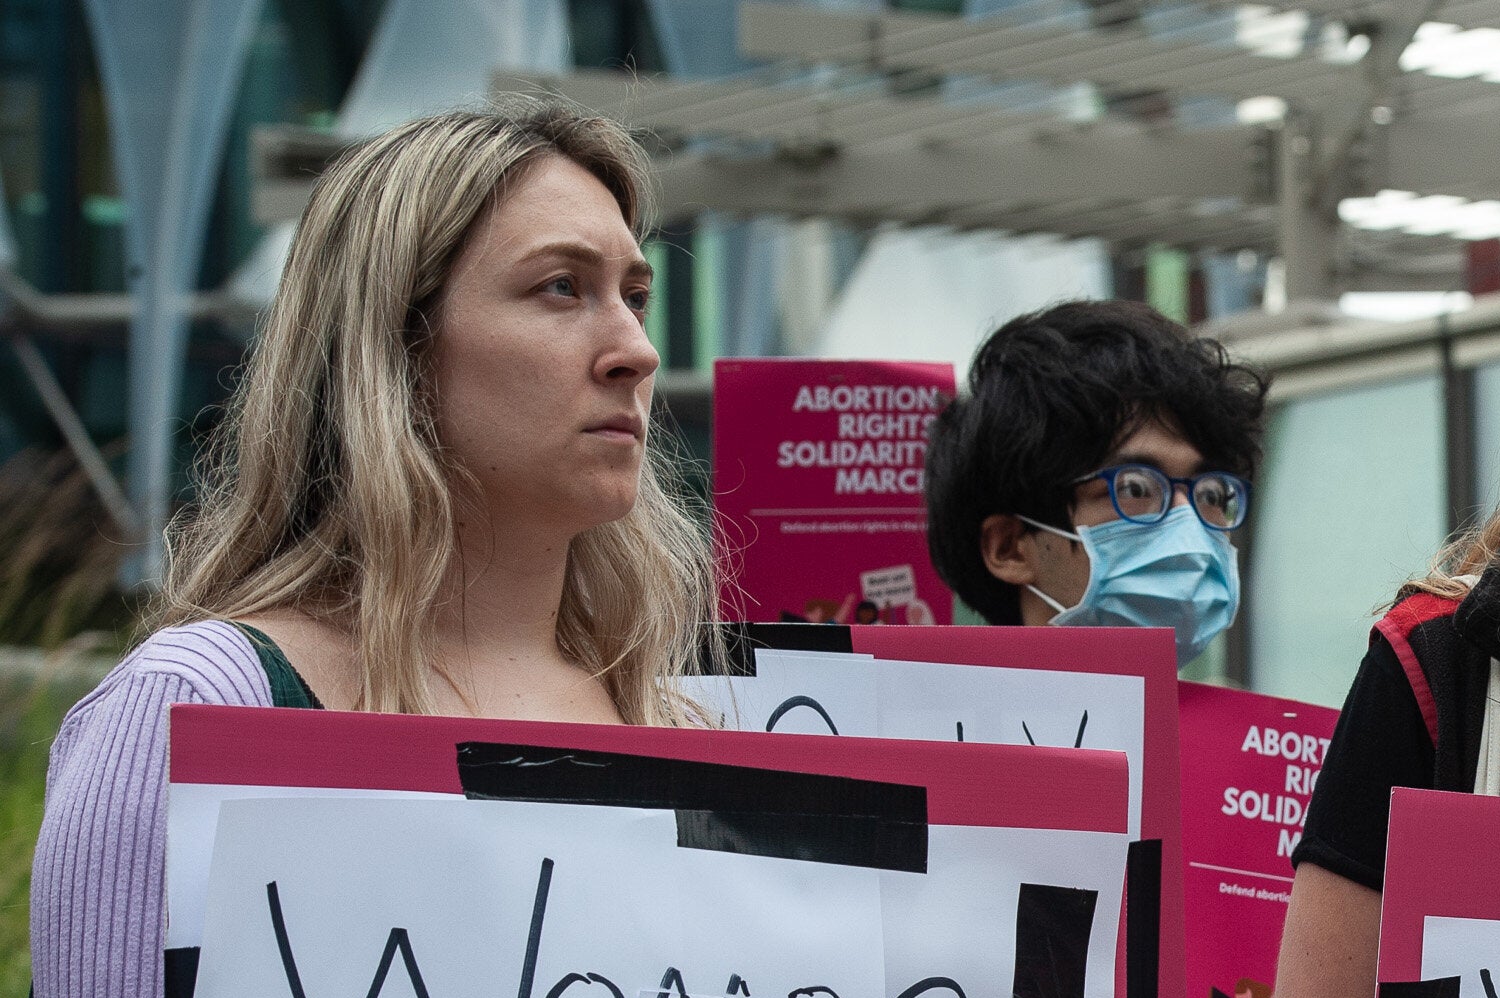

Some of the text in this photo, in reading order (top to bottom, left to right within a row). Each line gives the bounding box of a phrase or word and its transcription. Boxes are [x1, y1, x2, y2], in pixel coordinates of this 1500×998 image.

[793, 385, 938, 411] ABORTION
[1241, 725, 1331, 764] ABORT
[1219, 882, 1291, 903] Defend abortio
